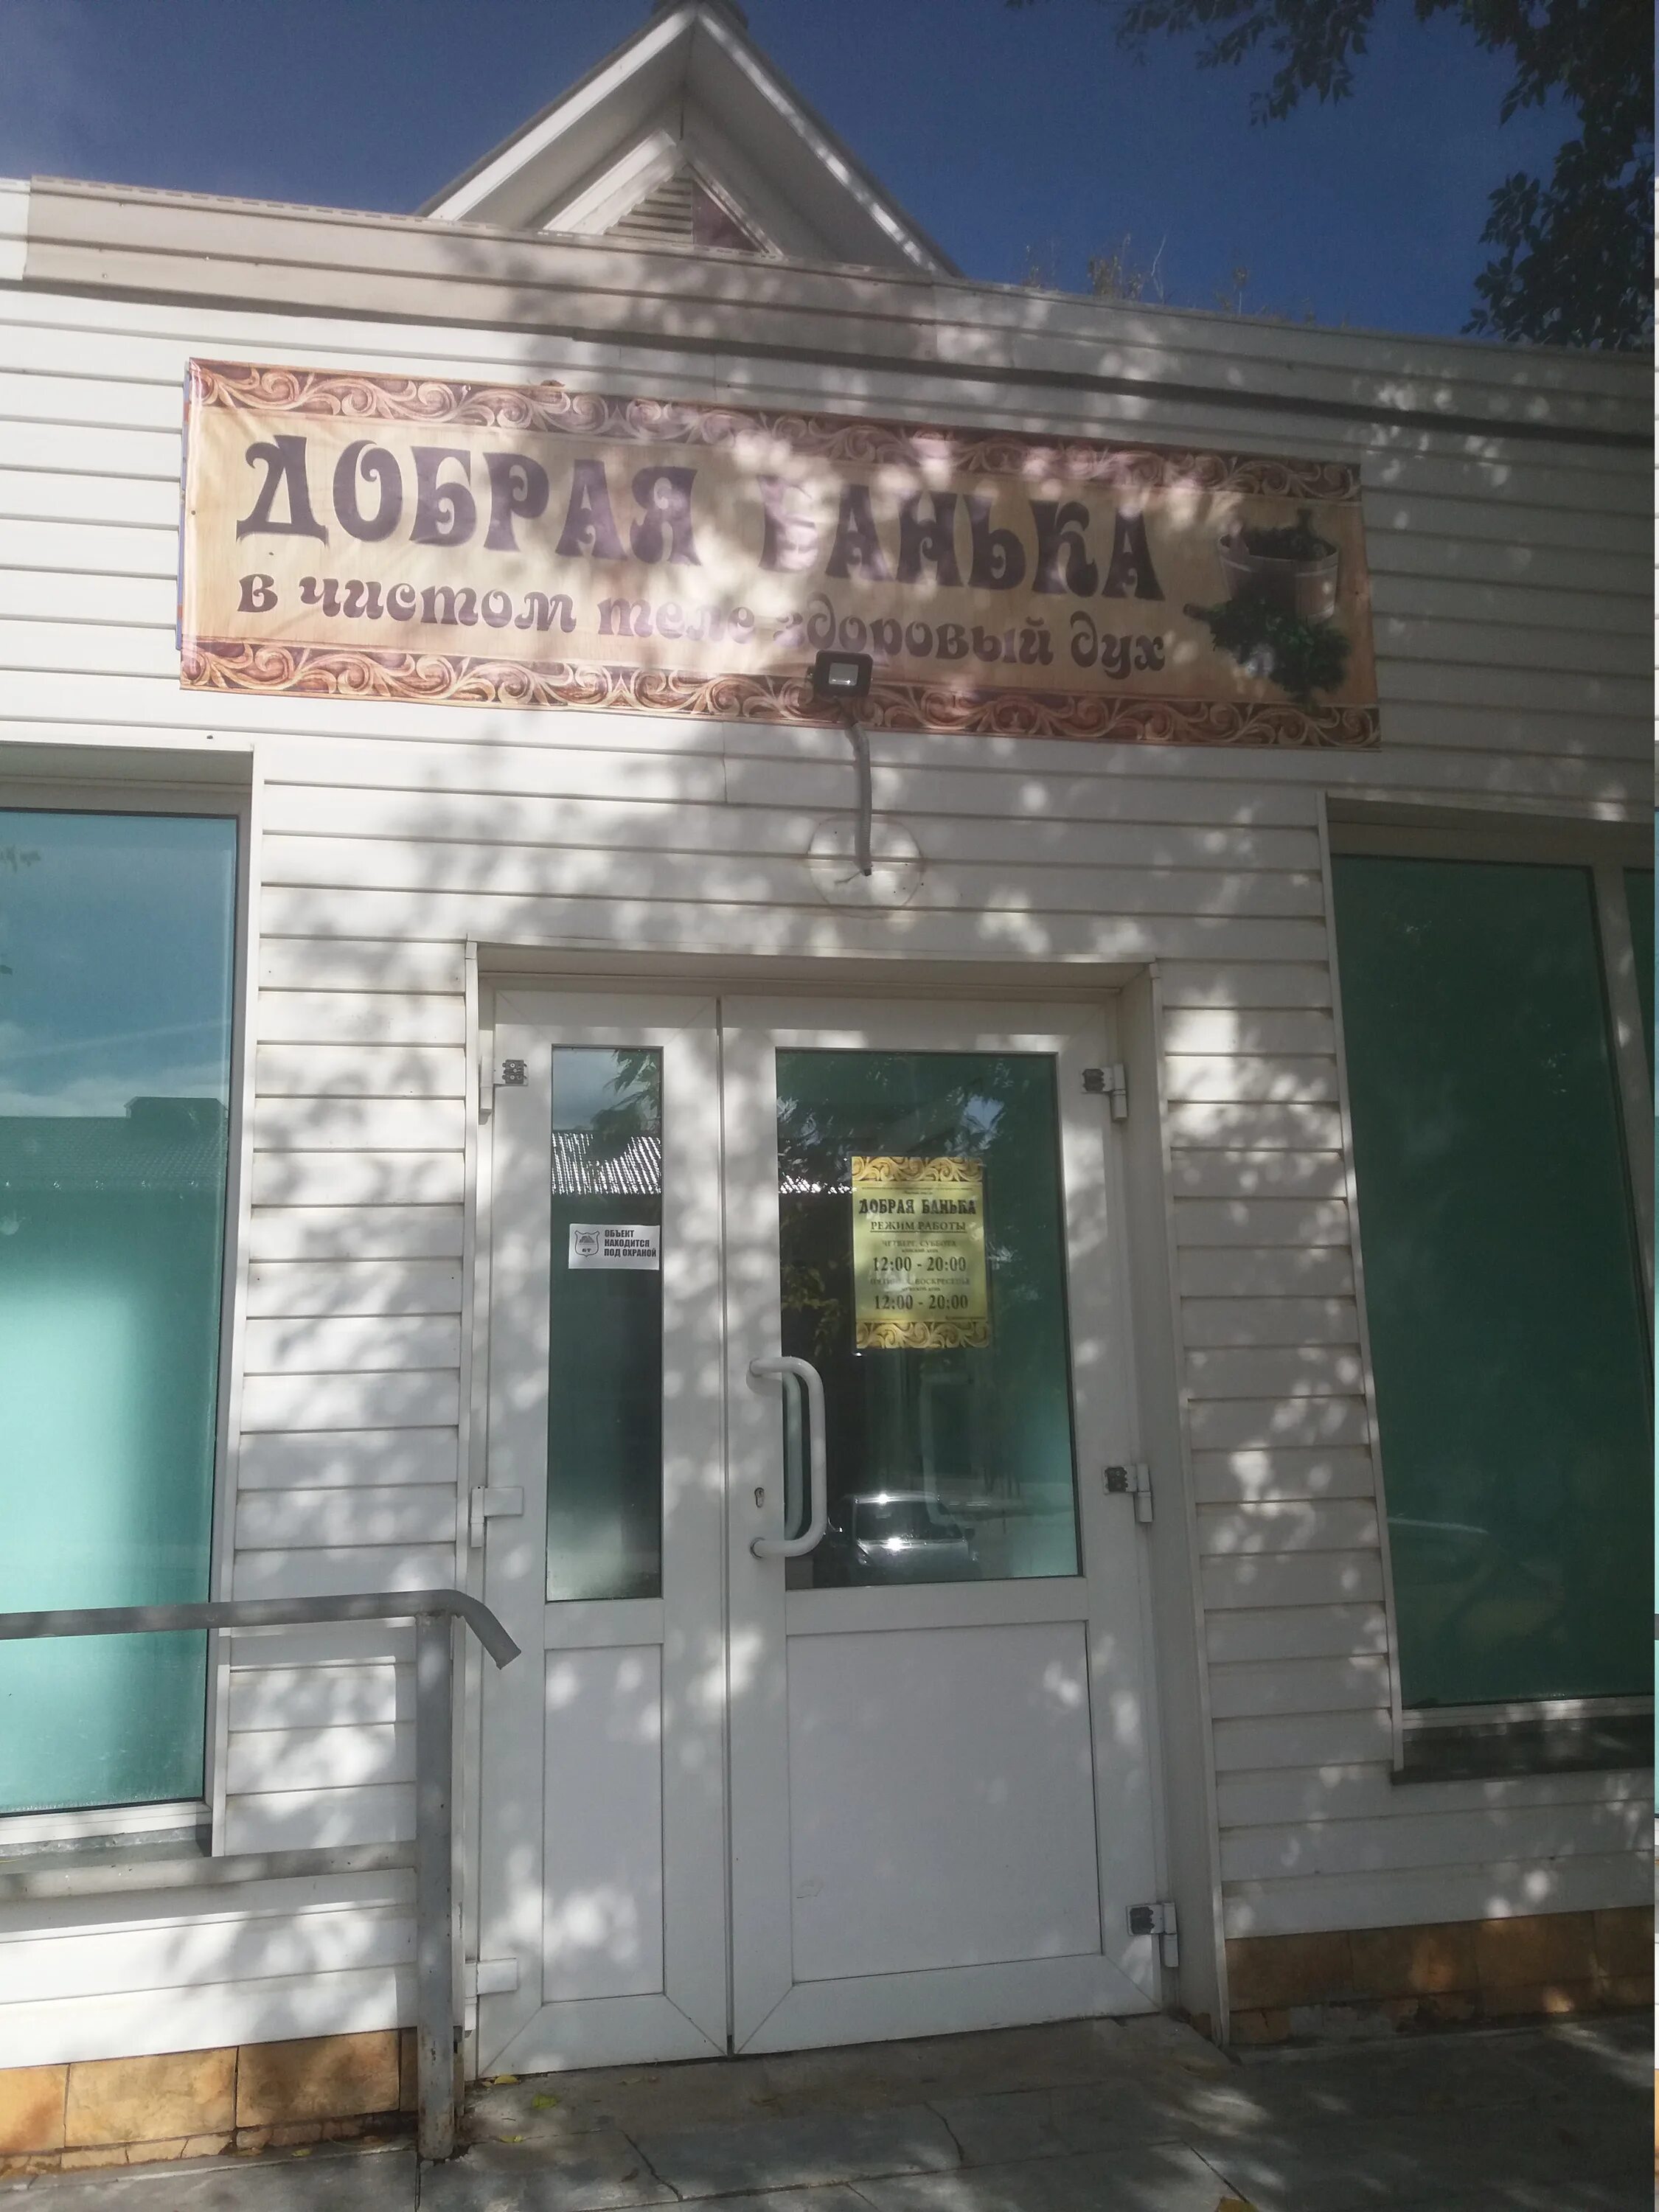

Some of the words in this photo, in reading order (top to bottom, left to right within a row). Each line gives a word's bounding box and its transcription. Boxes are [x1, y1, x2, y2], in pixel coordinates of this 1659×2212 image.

[236, 434, 700, 566] ДОБРАЯ
[757, 474, 1166, 601] БАНЬКА
[237, 573, 279, 613] в
[298, 575, 577, 634] чистом
[597, 597, 755, 645] теле
[773, 591, 1054, 666] здоровый
[1070, 611, 1166, 680] дух
[859, 1198, 915, 1214] ДОБРАЯ
[922, 1198, 977, 1215] БАНЬКА
[604, 1229, 635, 1238] ОБЪЕКТ
[871, 1221, 914, 1231] РЕЖИМ
[918, 1221, 966, 1231] РАБОТЫ
[604, 1239, 650, 1248] НАХОДИТСЯ
[604, 1248, 621, 1258] ПОД
[622, 1248, 657, 1257] ОХРАНОЙ
[873, 1256, 912, 1272] 12:00
[926, 1256, 967, 1272] 20:00
[875, 1295, 914, 1310] 12:00
[928, 1295, 969, 1310] 20:00
